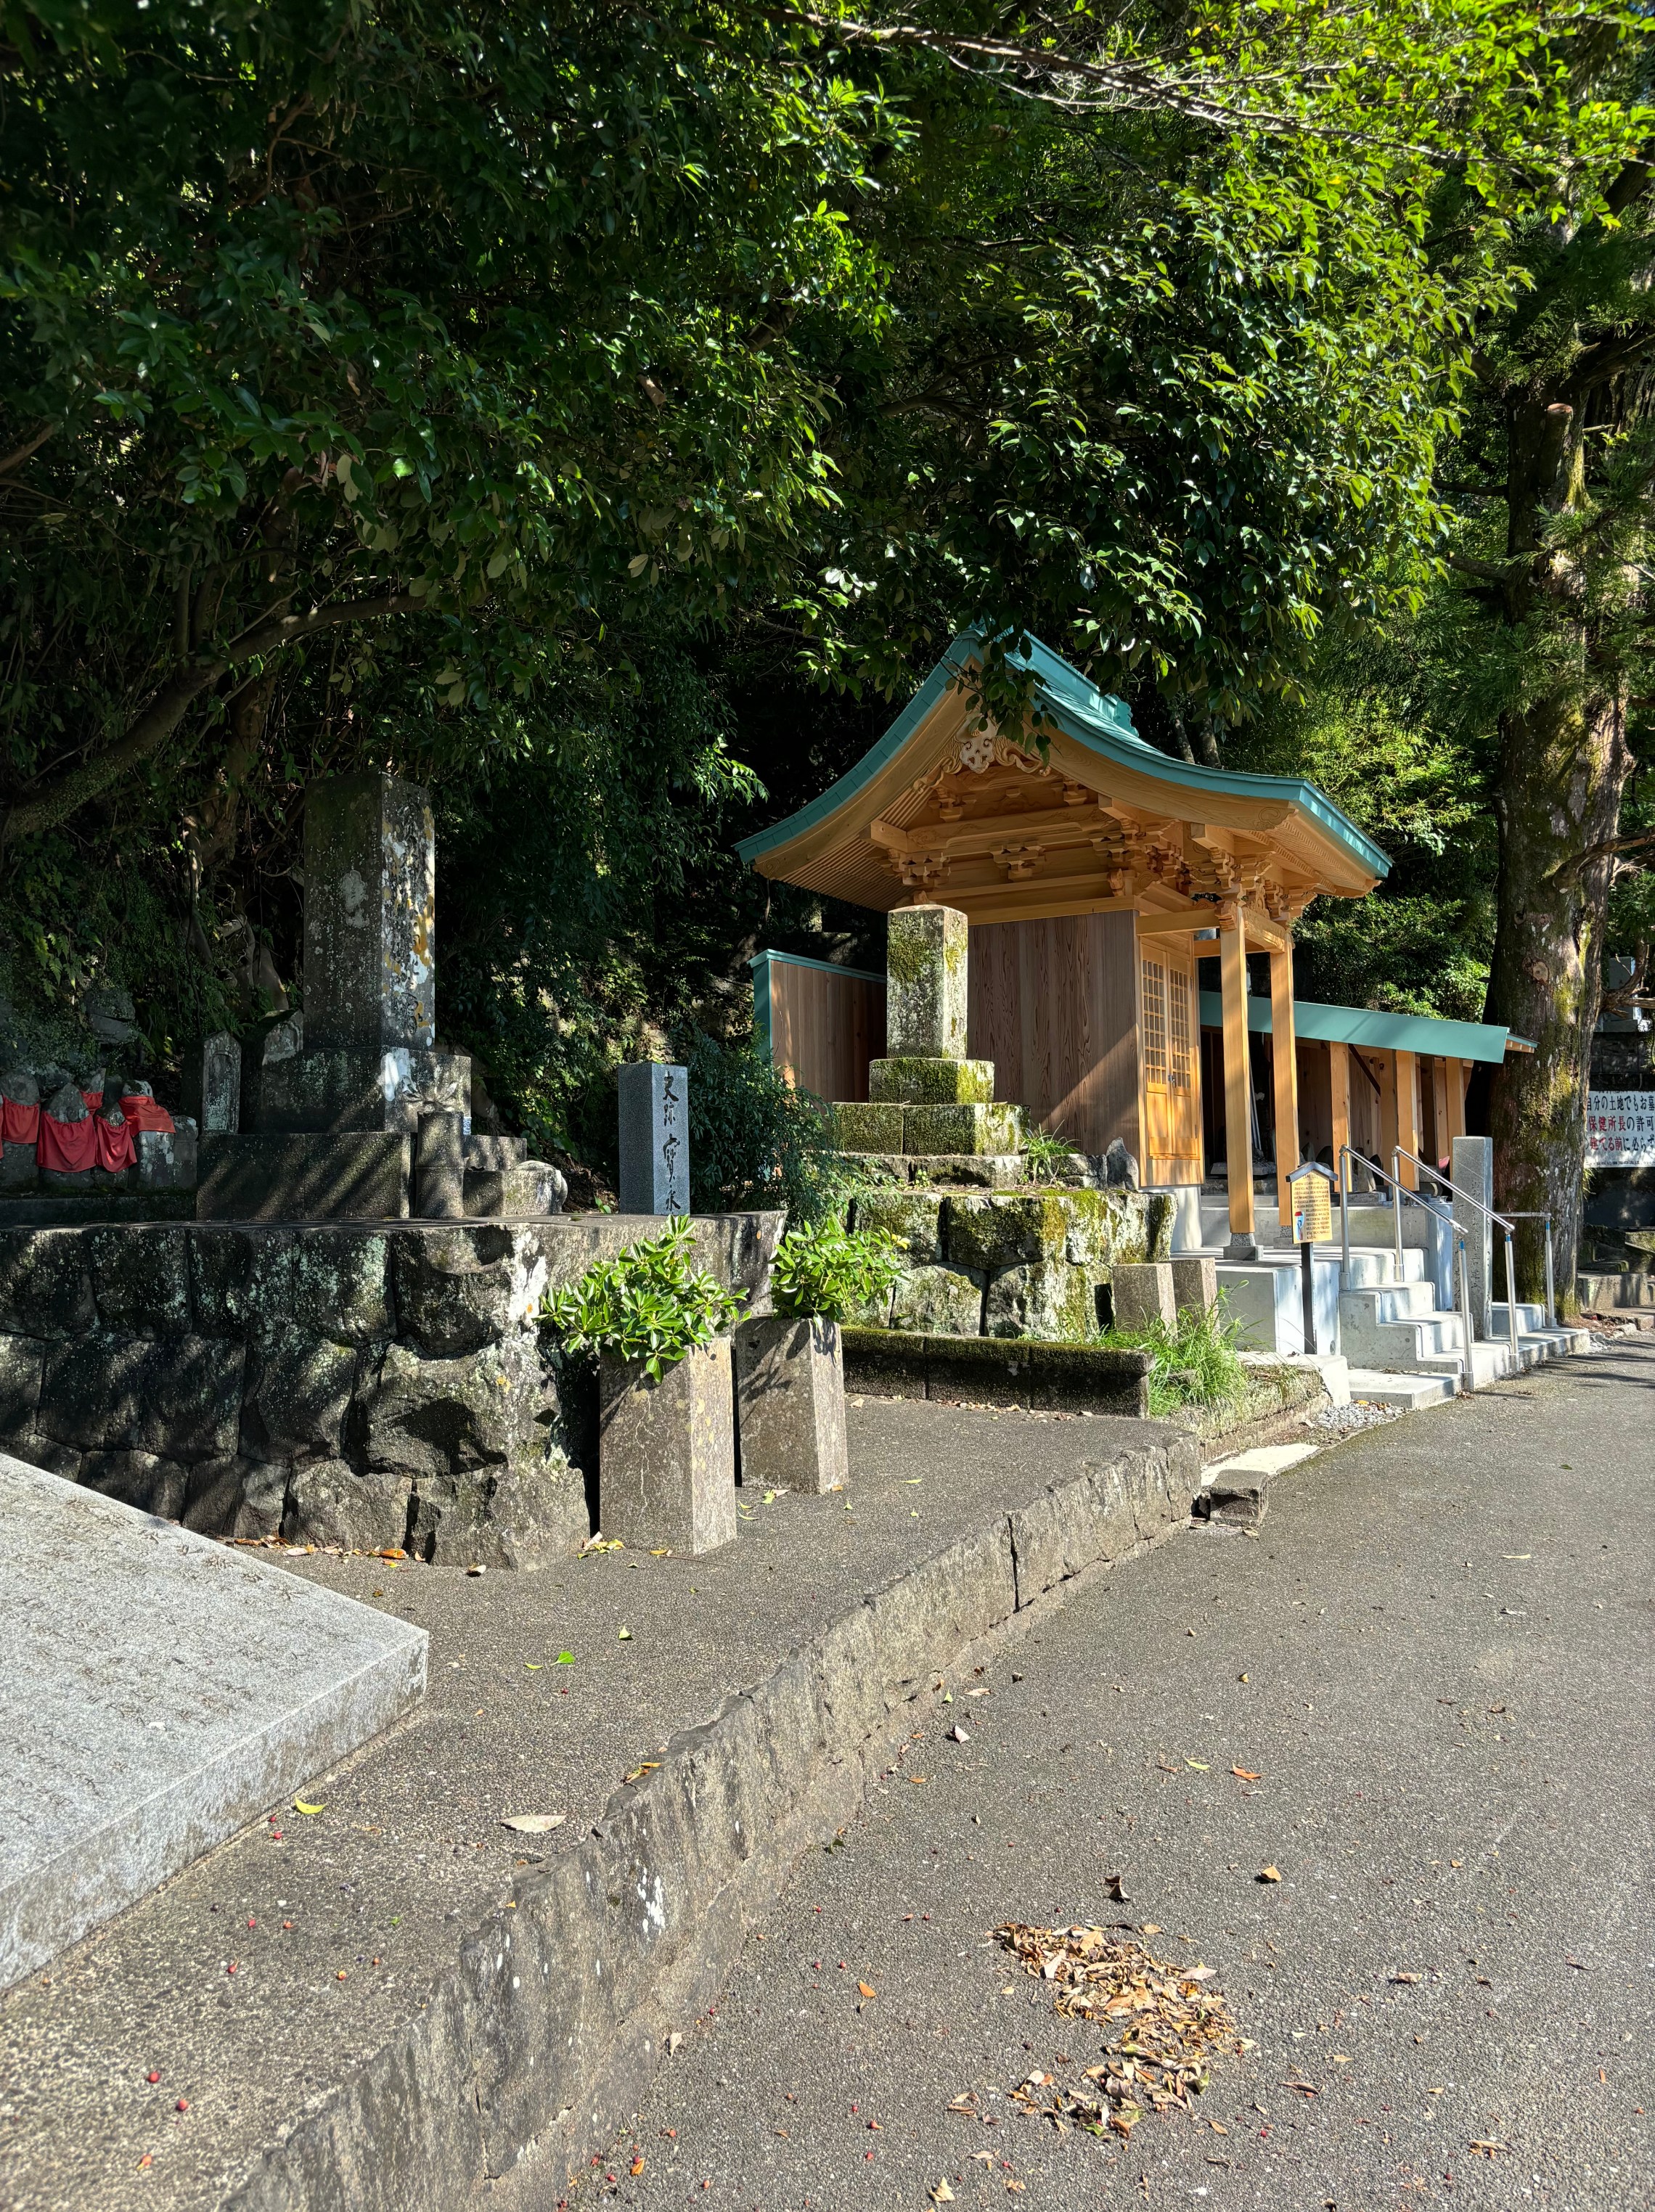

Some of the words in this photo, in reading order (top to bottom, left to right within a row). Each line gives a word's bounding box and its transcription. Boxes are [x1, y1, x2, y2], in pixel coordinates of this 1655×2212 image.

[1587, 1094, 1655, 1111] 自分の土地でもお墓
[1588, 1115, 1654, 1131] 保健所長の許可
[1585, 1134, 1655, 1152] 建てる前に必らず
